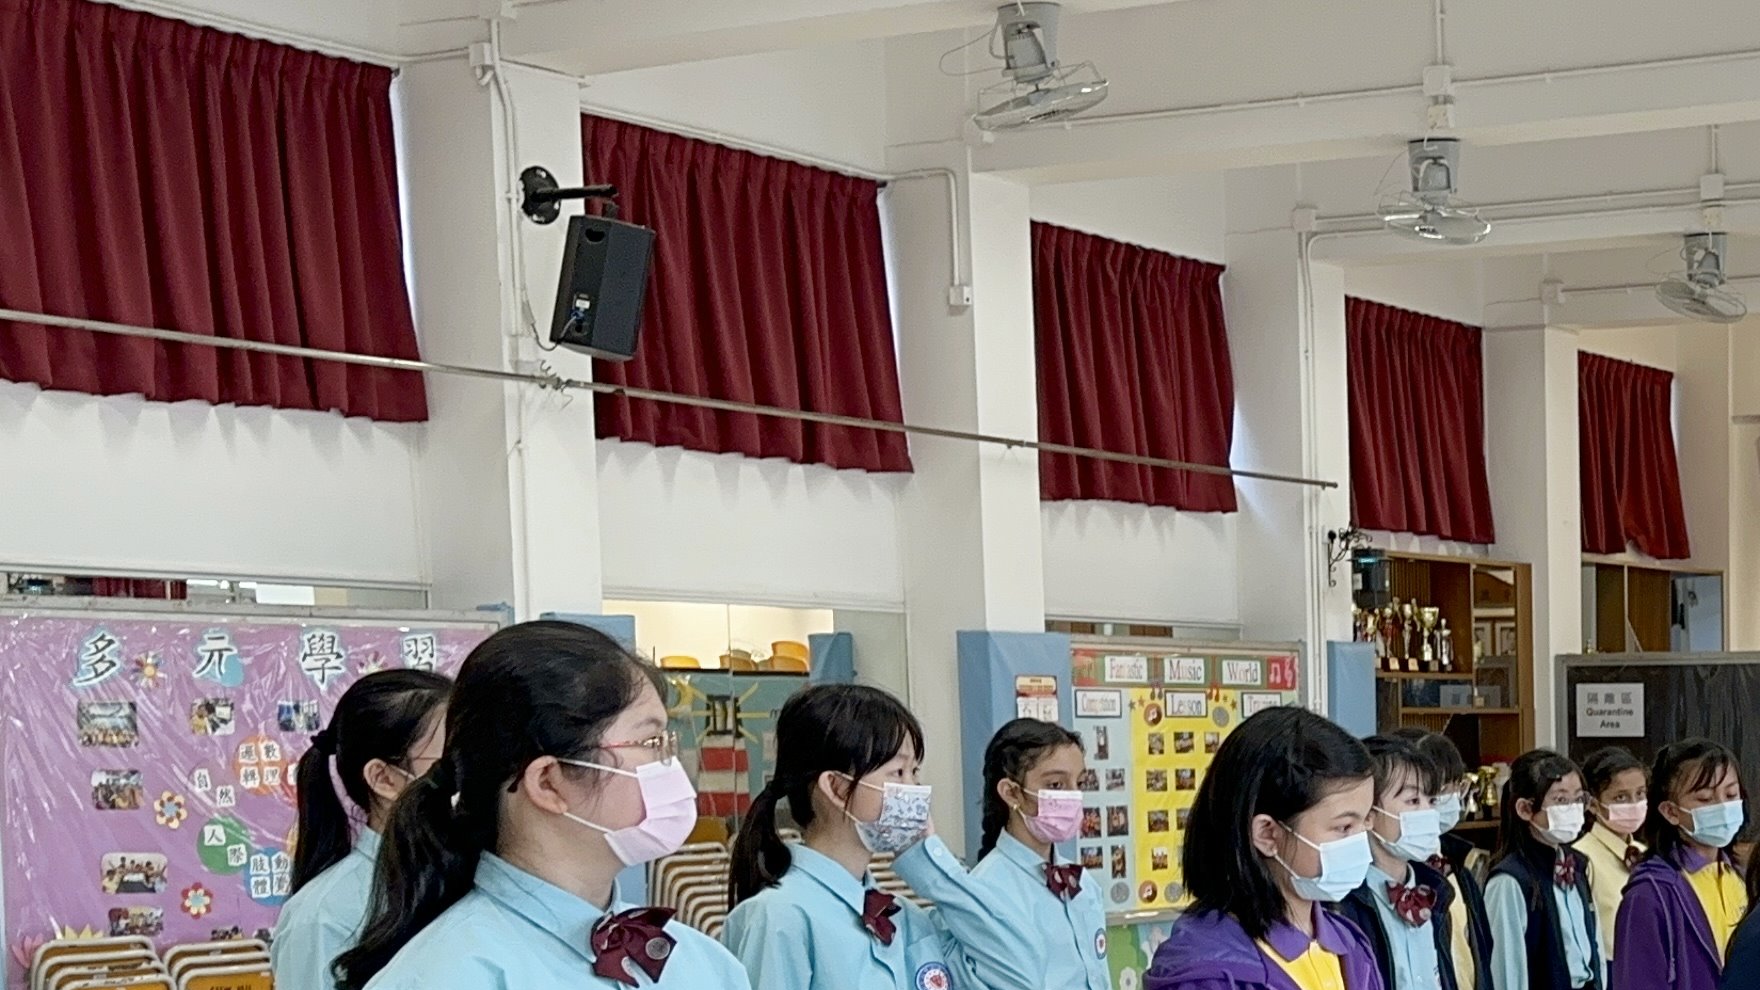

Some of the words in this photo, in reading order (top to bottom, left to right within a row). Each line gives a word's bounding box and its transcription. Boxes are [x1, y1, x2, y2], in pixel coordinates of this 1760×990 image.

[1169, 659, 1202, 681] Music
[1227, 661, 1258, 682] World
[1171, 694, 1202, 715] Lesson
[1586, 707, 1634, 717] Quarantine
[1600, 719, 1621, 729] Area
